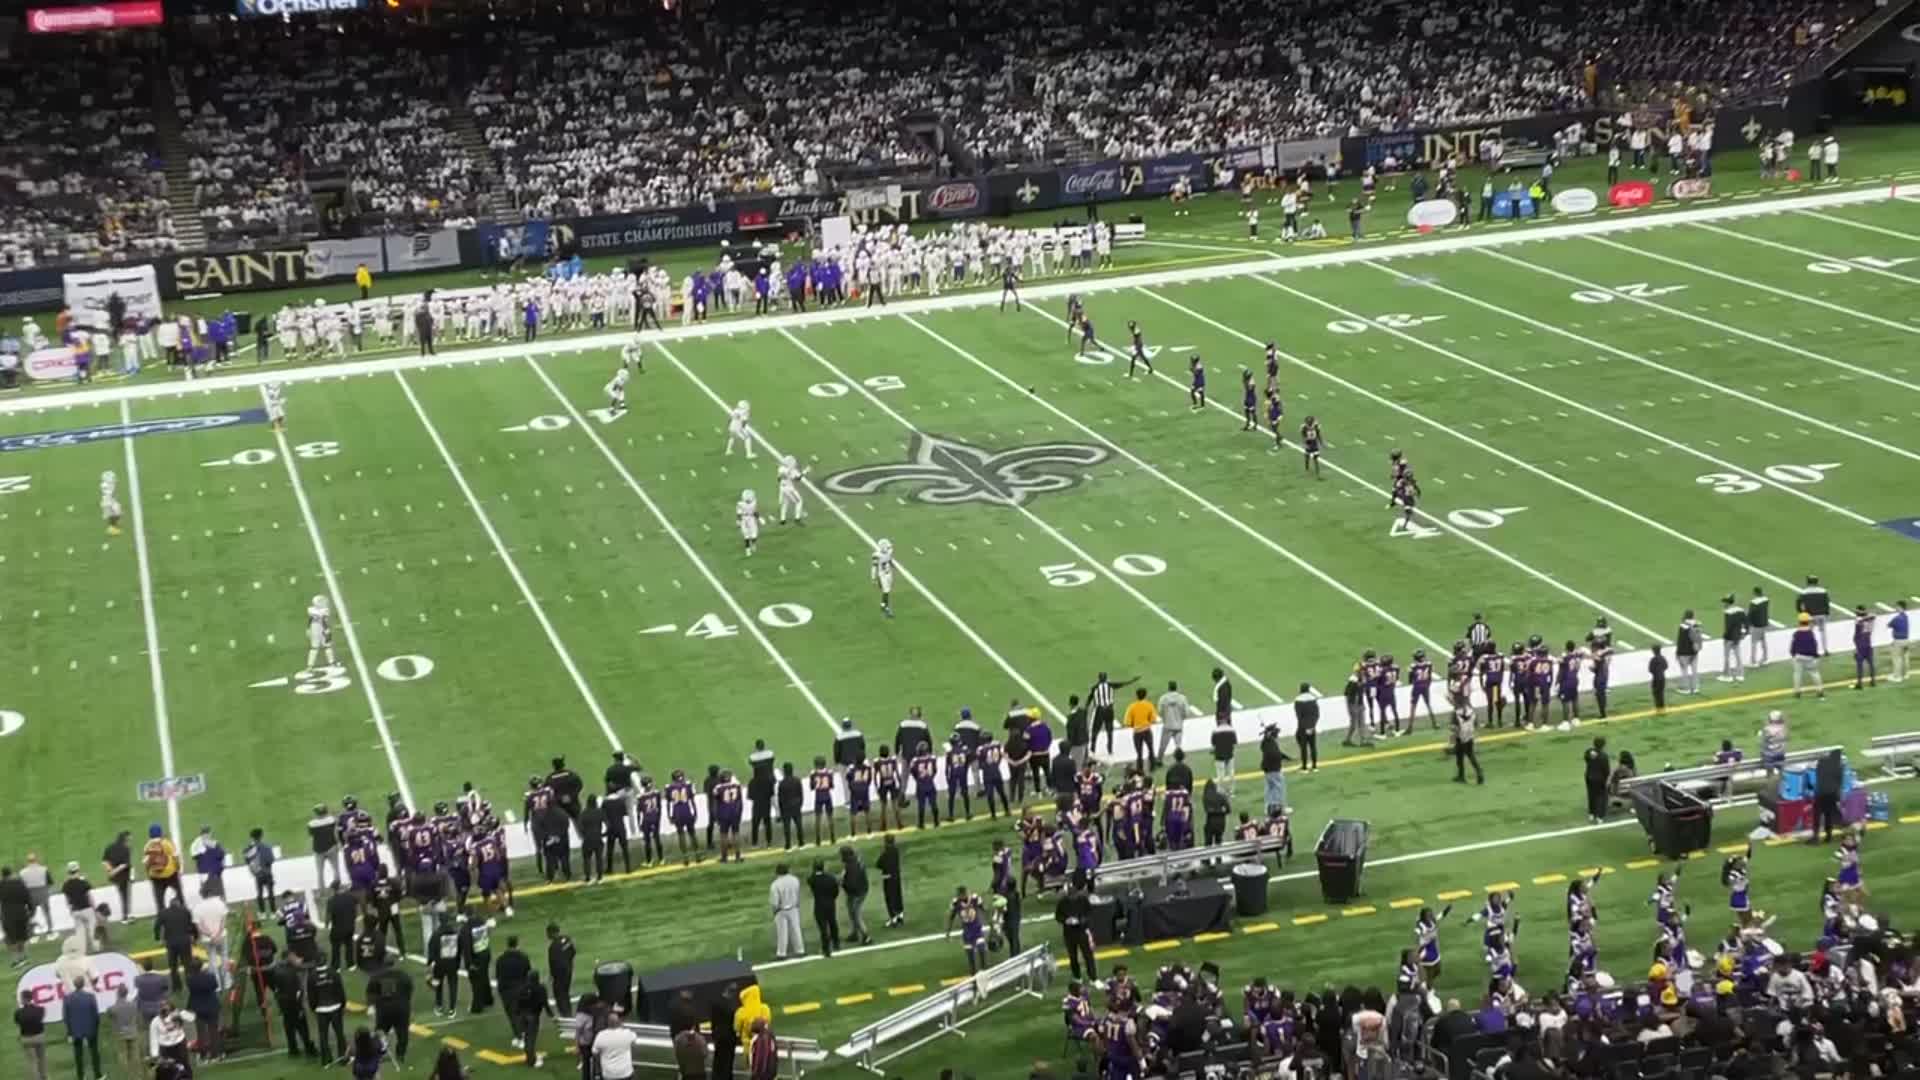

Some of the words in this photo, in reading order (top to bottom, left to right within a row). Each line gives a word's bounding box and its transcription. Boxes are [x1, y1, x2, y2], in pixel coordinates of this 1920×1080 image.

[581, 232, 622, 249] STATE
[623, 220, 734, 243] CHAMPIONSHIPS
[175, 245, 331, 291] SAINTS
[1695, 462, 1827, 495] 30
[1039, 553, 1168, 588] 50
[683, 602, 814, 641] 40
[293, 653, 435, 694] 30
